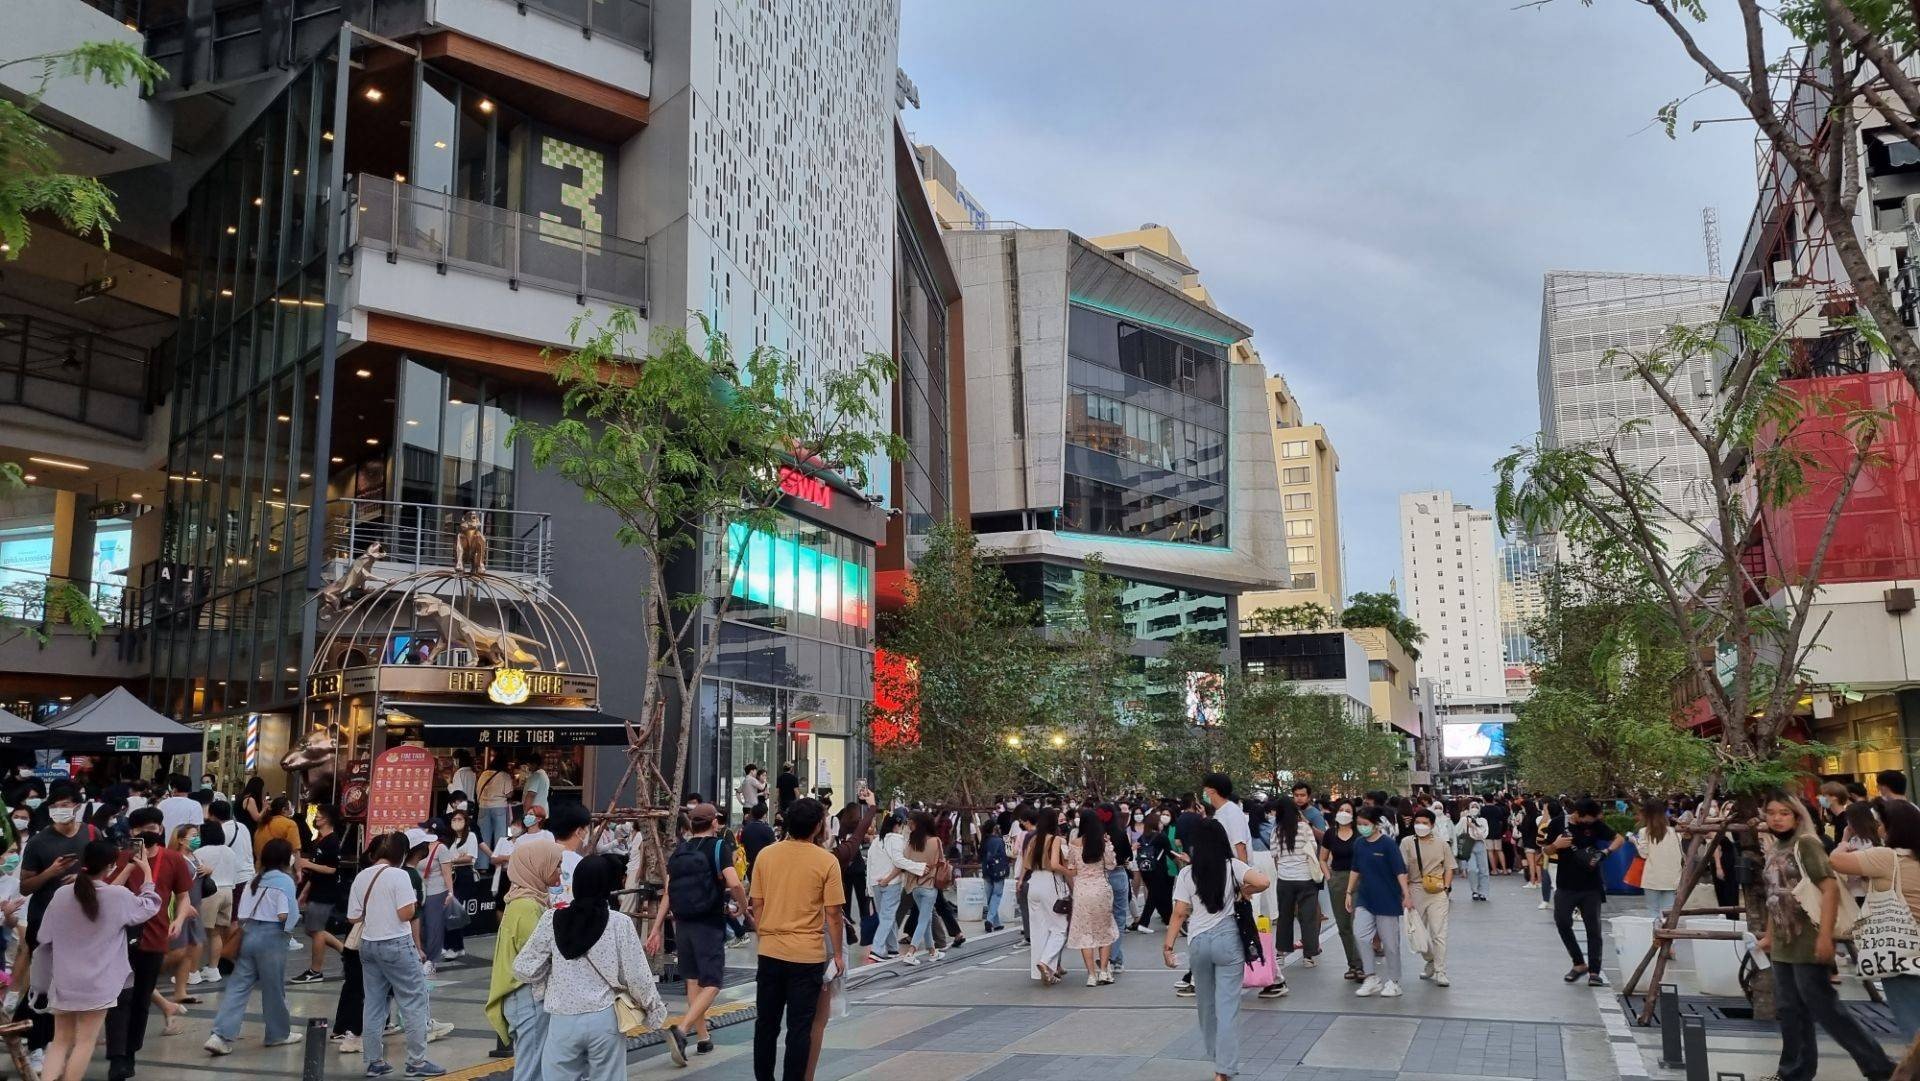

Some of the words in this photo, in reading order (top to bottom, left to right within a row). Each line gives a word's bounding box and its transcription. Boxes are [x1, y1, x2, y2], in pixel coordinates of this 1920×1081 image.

[540, 135, 603, 256] 3
[449, 671, 484, 691] FIRE
[526, 675, 564, 695] TIGER
[497, 730, 519, 743] FIRE
[526, 730, 554, 743] TIGER
